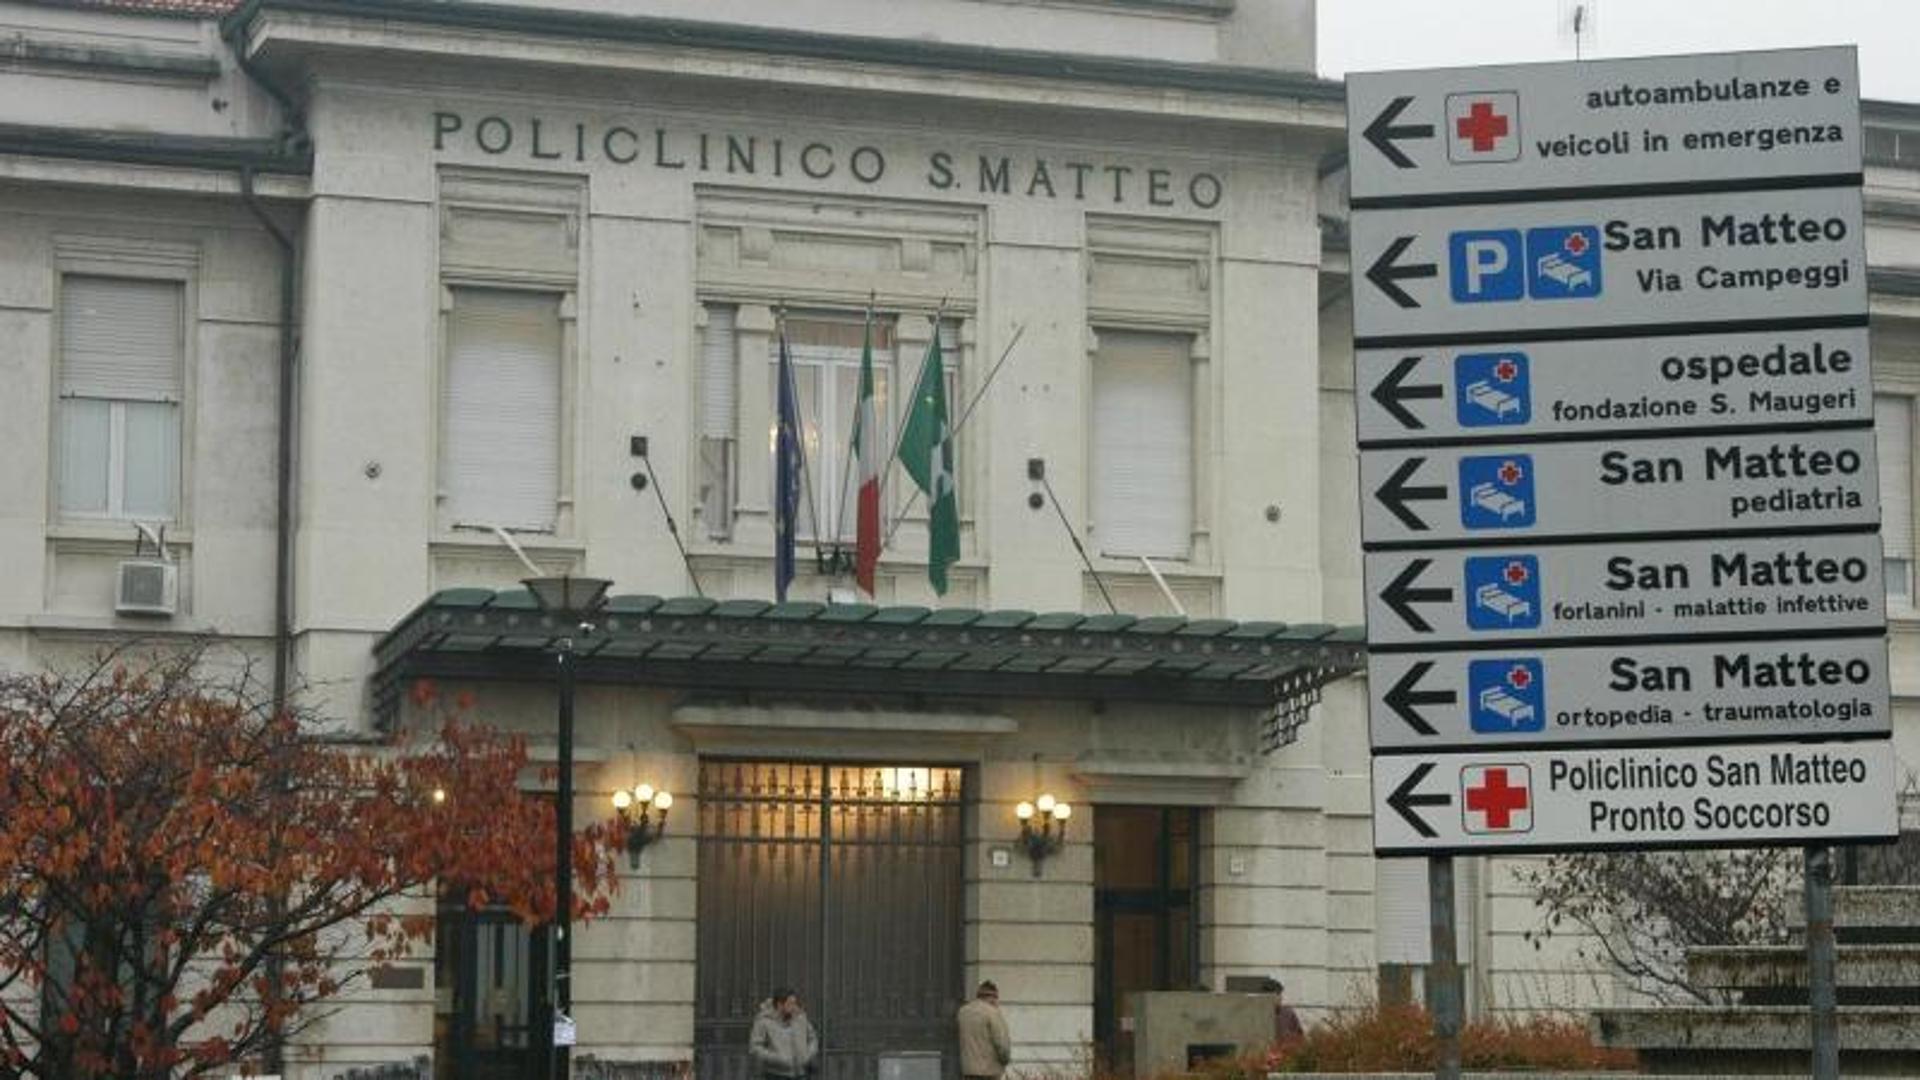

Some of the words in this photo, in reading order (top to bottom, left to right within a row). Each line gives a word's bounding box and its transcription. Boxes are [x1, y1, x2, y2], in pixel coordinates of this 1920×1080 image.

[1587, 78, 1810, 108] autoambulanze
[1824, 77, 1840, 94] e
[432, 110, 886, 184] POLICLINICO
[1536, 131, 1629, 157] veicoli
[1644, 132, 1668, 151] in
[1683, 125, 1843, 151] emergenza
[1604, 220, 1680, 251] San
[1702, 213, 1846, 247] Matteo
[1466, 240, 1508, 293] P
[1637, 269, 1681, 292] Via
[1697, 259, 1848, 290] Campeggi
[1661, 342, 1851, 385] ospedale
[1553, 397, 1697, 421] fondazione
[1711, 393, 1735, 414] S.
[1750, 388, 1855, 414] Maugeri
[1600, 451, 1682, 485] San
[1706, 444, 1860, 480] Matteo
[1732, 486, 1862, 518] pediatria
[1606, 557, 1689, 591] San
[1711, 552, 1867, 587] Matteo
[1554, 601, 1644, 620] forlanini
[1675, 598, 1766, 617] malattie
[1777, 595, 1868, 613] infettive
[1610, 657, 1690, 691] San
[1714, 653, 1870, 688] Matteo
[1557, 705, 1672, 728] ortopedia
[1703, 698, 1872, 721] traumatologia
[1550, 757, 1697, 791] Policlinico
[1707, 756, 1760, 787] San
[1771, 753, 1866, 784] Matteo
[1590, 801, 1685, 832] Pronto
[1694, 797, 1829, 830] Soccorso
